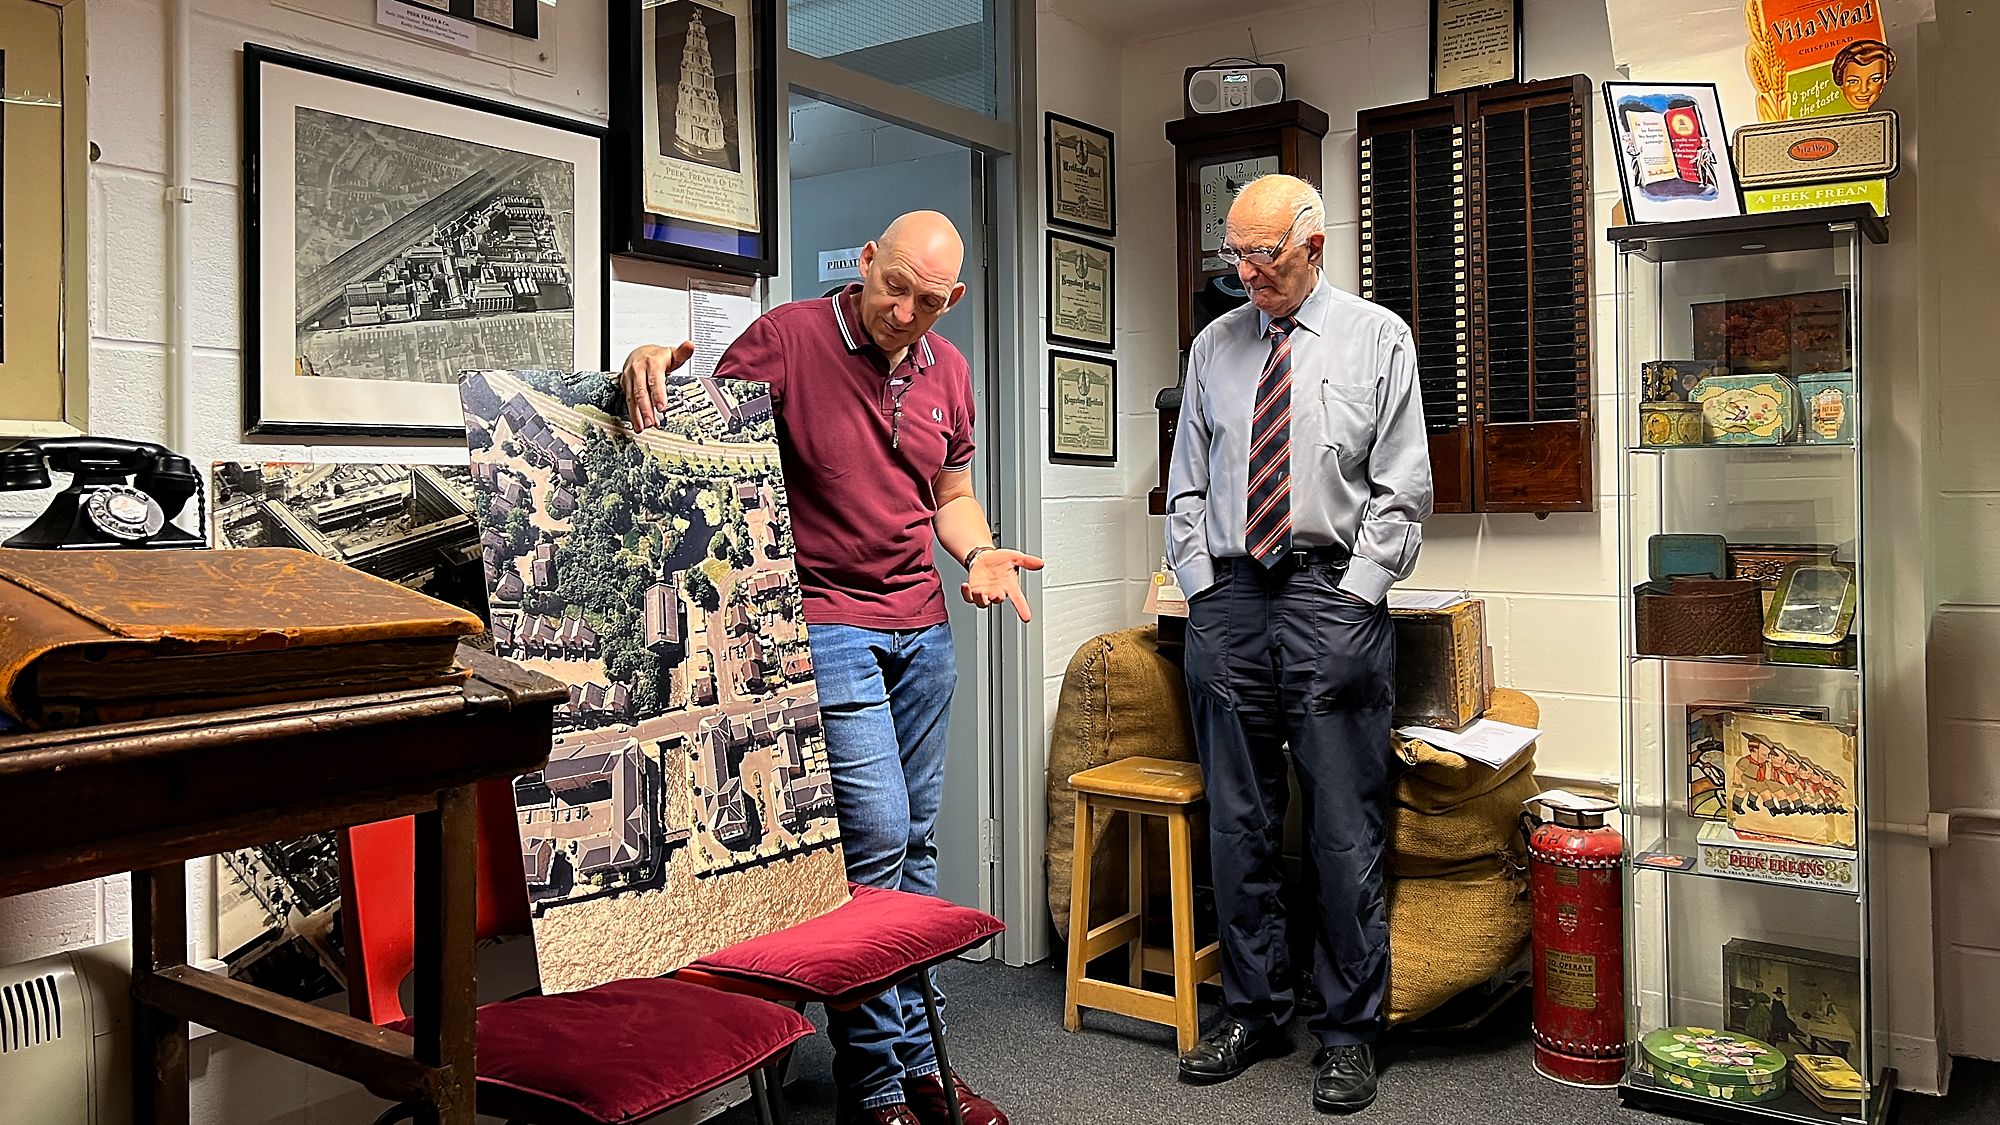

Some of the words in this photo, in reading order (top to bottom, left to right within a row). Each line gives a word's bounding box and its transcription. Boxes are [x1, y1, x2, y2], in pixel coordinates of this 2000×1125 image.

[1771, 0, 1872, 44] Vita-Weat
[1798, 36, 1853, 55] CRISPBREAD
[1800, 80, 1829, 102] prefer
[1800, 104, 1815, 117] the
[1816, 91, 1839, 109] taste
[1219, 166, 1224, 176] 11
[1236, 163, 1243, 174] 12
[689, 172, 710, 182] FREAN
[1204, 184, 1211, 195] 10
[1756, 196, 1765, 204] A
[1772, 191, 1809, 203] PEEK
[1816, 186, 1868, 199] FREAN
[1205, 204, 1211, 214] 9
[1206, 223, 1211, 233] 8
[828, 258, 859, 270] PRIVAT
[1729, 854, 1767, 870] PEEK
[1768, 856, 1825, 876] FREANS
[1559, 961, 1592, 972] OPERATE
